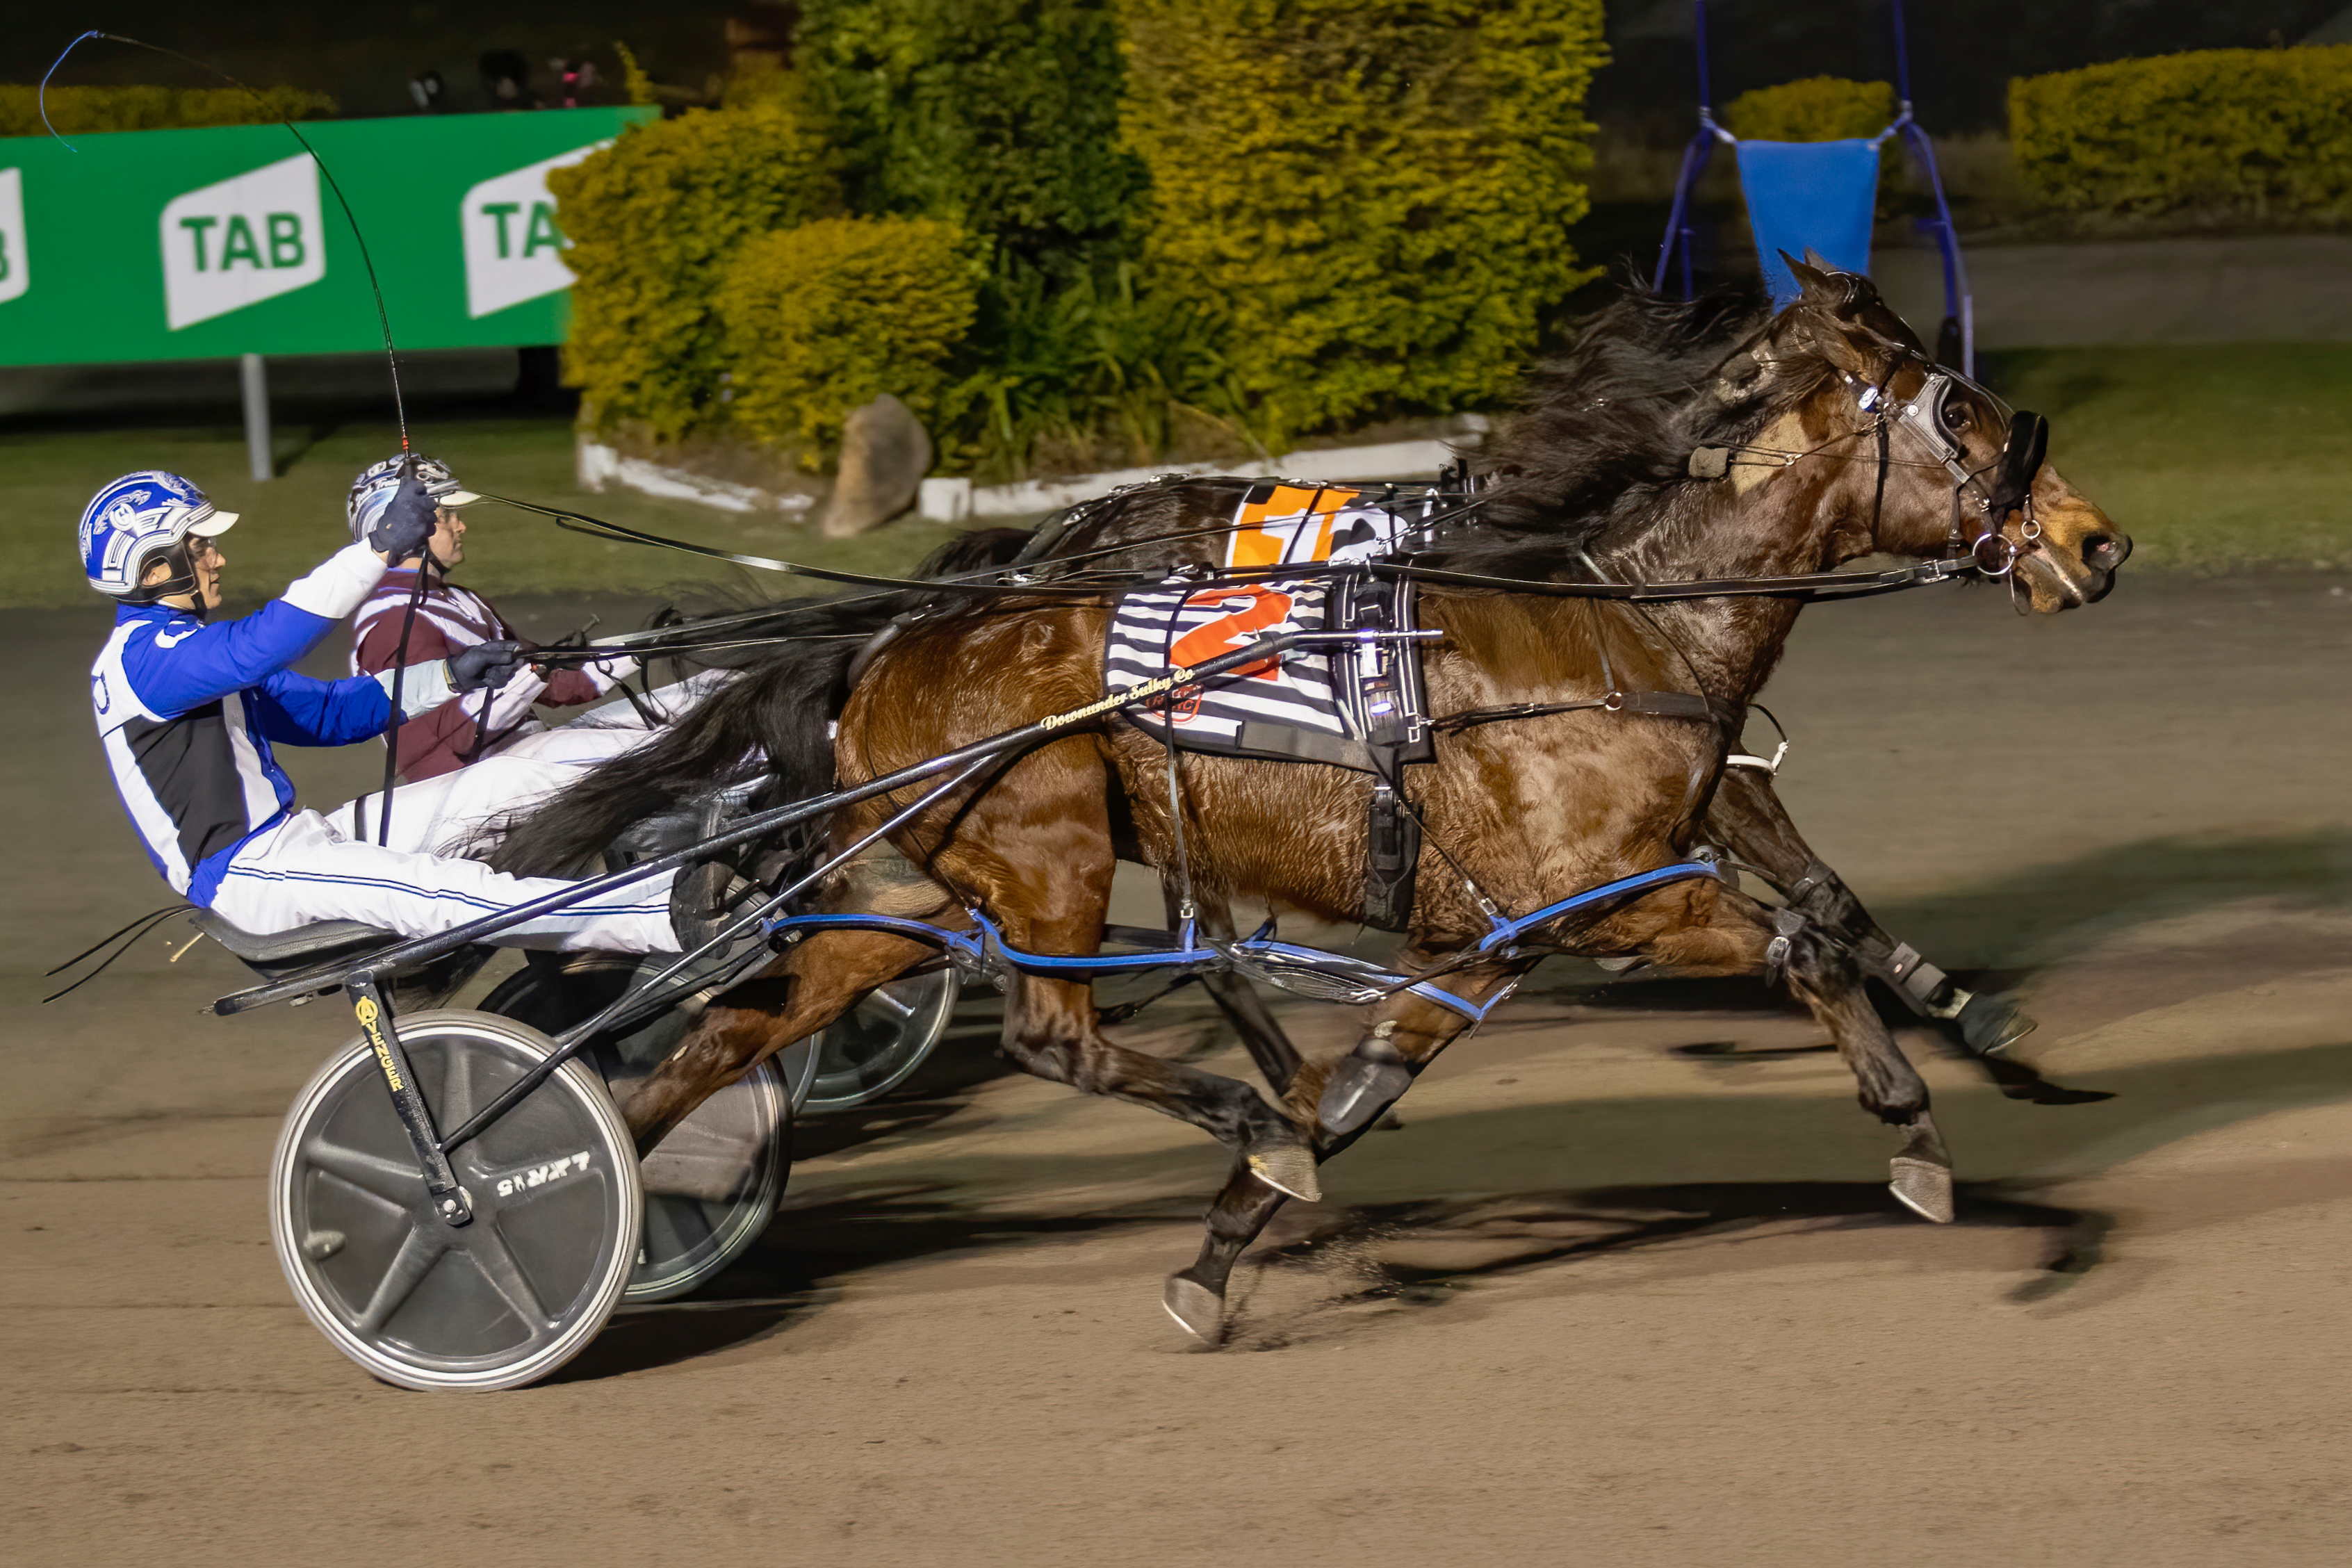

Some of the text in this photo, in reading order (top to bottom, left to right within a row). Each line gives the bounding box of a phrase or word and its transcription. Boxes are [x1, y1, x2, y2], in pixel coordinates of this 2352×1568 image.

[179, 214, 305, 272] TAB
[481, 201, 564, 259] TA
[1170, 584, 1293, 681] 2
[1040, 694, 1127, 730] Downunder
[1129, 676, 1174, 701] Sulky
[1173, 668, 1195, 683] Co
[356, 995, 404, 1092] AVENGER
